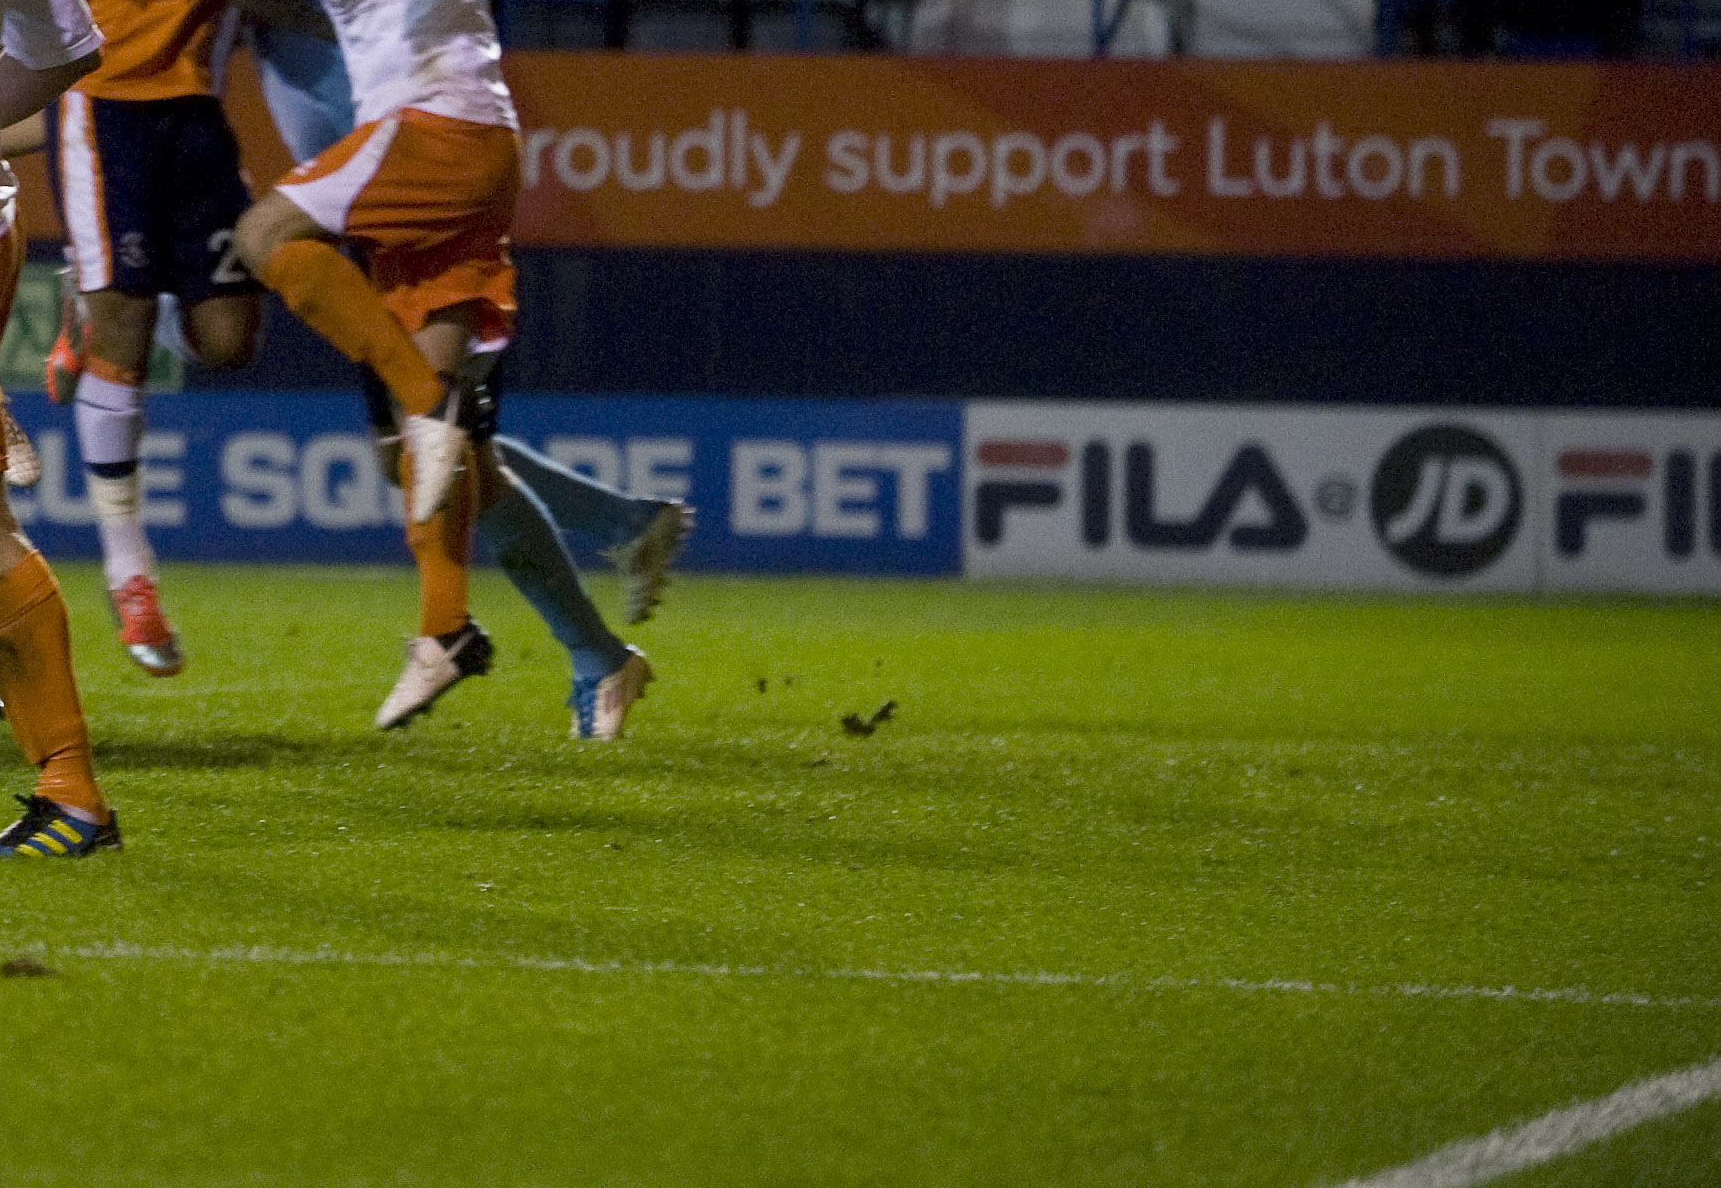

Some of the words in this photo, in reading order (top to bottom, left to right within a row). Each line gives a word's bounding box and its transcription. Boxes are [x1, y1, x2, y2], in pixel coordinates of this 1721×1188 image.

[519, 108, 801, 209] roudly
[826, 118, 1179, 209] support
[1207, 114, 1462, 201] Luton
[1486, 117, 1721, 203] Town
[730, 438, 951, 540] BET
[975, 438, 1310, 553] FILA
[1385, 452, 1512, 546] JD
[1556, 449, 1721, 560] FI
